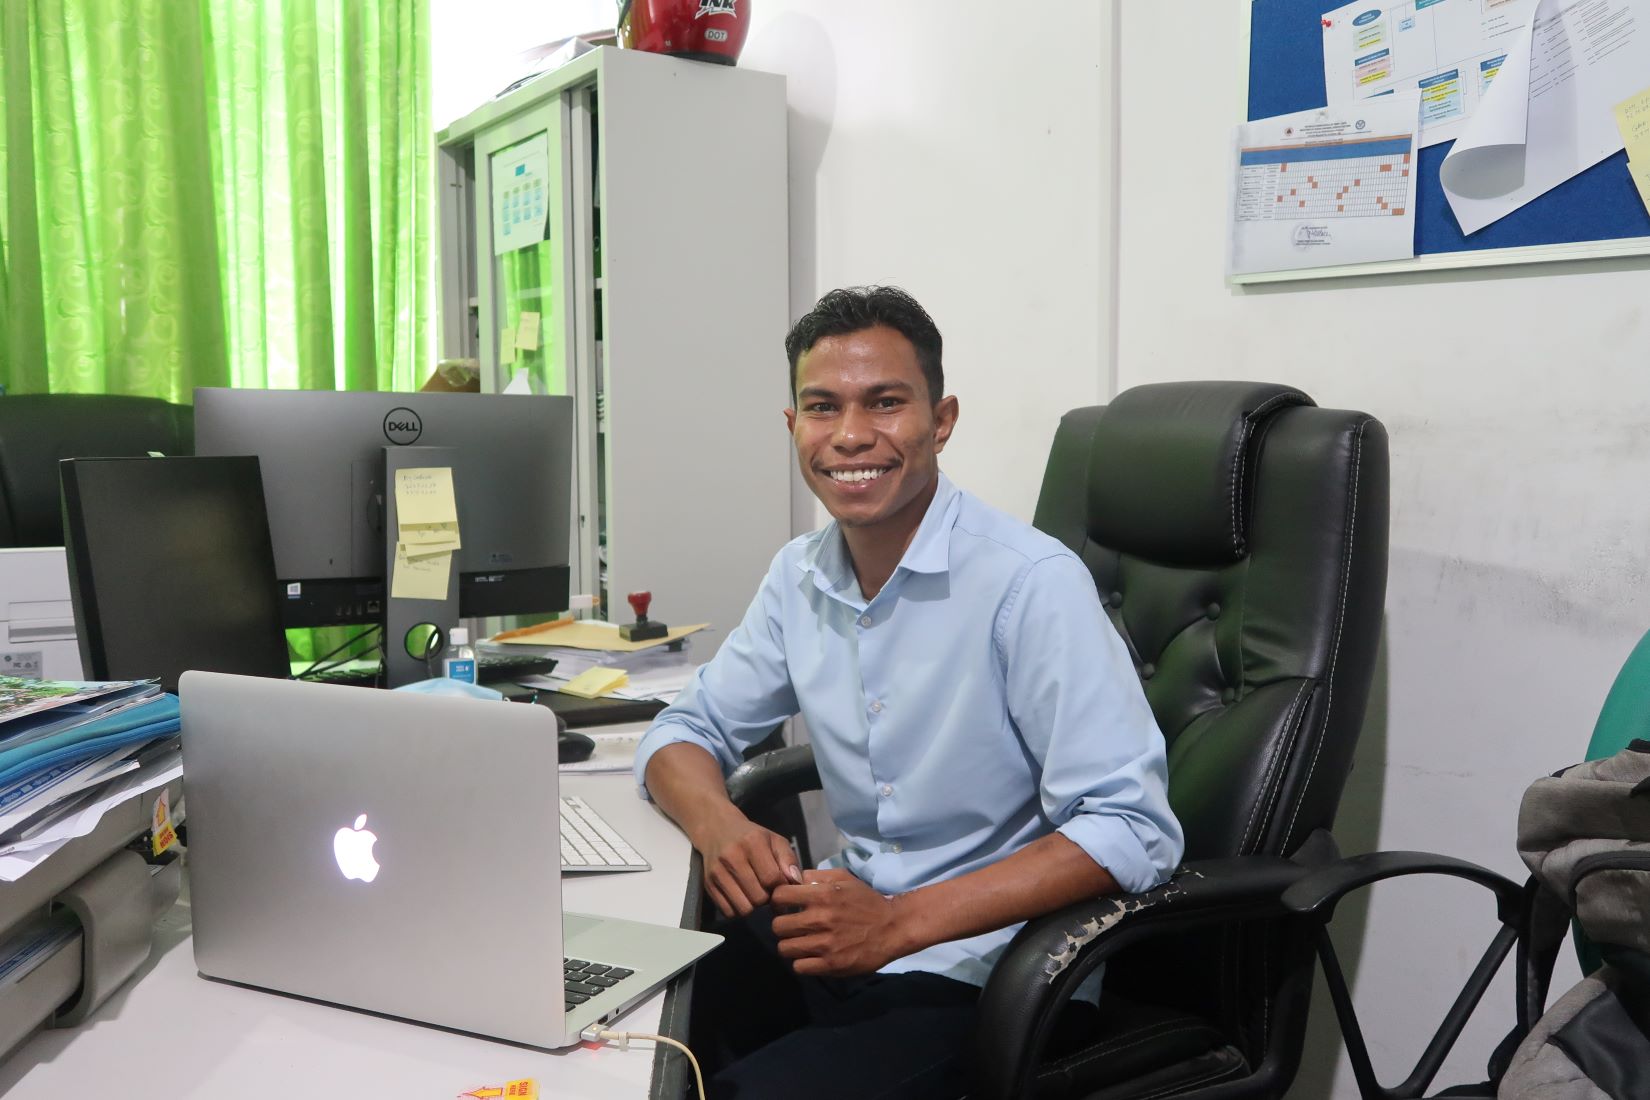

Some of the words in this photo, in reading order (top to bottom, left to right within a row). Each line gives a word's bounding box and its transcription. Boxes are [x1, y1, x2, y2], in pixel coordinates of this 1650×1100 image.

[708, 30, 725, 40] DOT
[388, 421, 419, 431] DELL
[518, 1081, 528, 1096] SIGN
